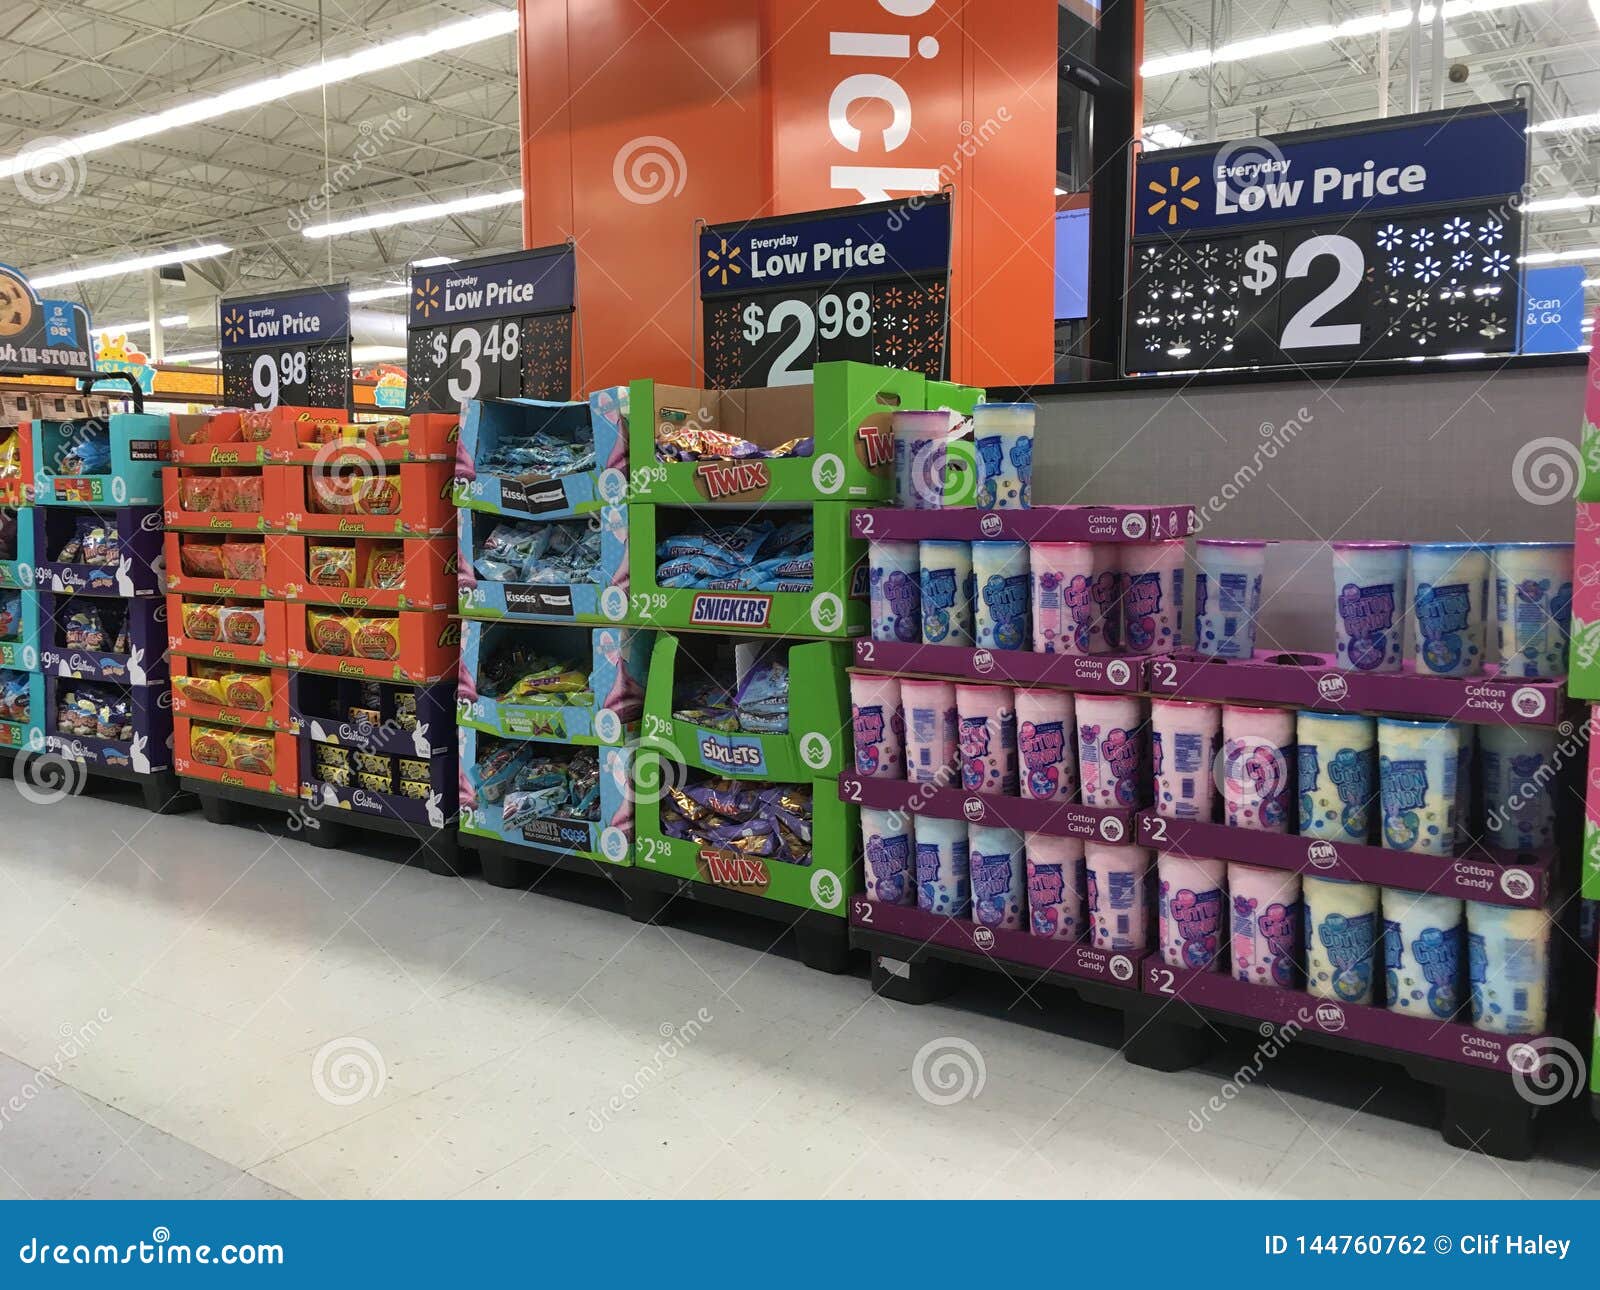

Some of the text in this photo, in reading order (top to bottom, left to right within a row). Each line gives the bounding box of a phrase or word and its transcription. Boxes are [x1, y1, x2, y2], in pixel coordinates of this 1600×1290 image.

[1217, 158, 1292, 179] Everyday
[1215, 160, 1427, 215] Low Price
[751, 235, 799, 249] Everyday
[751, 238, 886, 279] Low Price
[445, 275, 478, 288] Everyday
[445, 279, 534, 312] Low Price
[1242, 234, 1366, 350] $2
[1527, 299, 1561, 311] Scan
[248, 308, 275, 320] Everyday
[1526, 312, 1561, 325] & Go
[248, 313, 320, 338] Low Price
[20, 347, 88, 366] IN-STORE
[698, 462, 769, 498] TWIX
[855, 513, 875, 534] $2
[983, 517, 1001, 529] FUN
[1088, 515, 1118, 525] Cotton
[1089, 525, 1117, 535] Candy
[693, 596, 769, 624] SNICKERS
[857, 641, 875, 662] $2
[974, 653, 993, 665] FUN
[1074, 658, 1103, 670] Cotton
[1075, 669, 1102, 681] Candy
[1153, 662, 1178, 687] $2
[1320, 677, 1344, 691] FUN
[1465, 685, 1506, 698] Cotton
[1466, 698, 1505, 712] Candy
[702, 737, 761, 764] SIXLETS
[844, 780, 863, 801] $2
[965, 801, 984, 813] FUN
[1066, 812, 1096, 824] Cotton
[1067, 823, 1096, 835] Candy
[1143, 816, 1168, 842] $2
[1310, 846, 1334, 858] FUN
[701, 851, 768, 884] TWIX
[1454, 862, 1495, 878] Cotton
[1455, 875, 1494, 891] Candy
[855, 901, 873, 923] $2
[975, 931, 993, 942] FUN
[1076, 948, 1106, 962] Cotton
[1078, 958, 1105, 973] Candy
[1150, 968, 1176, 994] $2
[1318, 1008, 1341, 1020] FUN
[1461, 1033, 1501, 1050] Cotton
[1462, 1046, 1500, 1063] Candy
